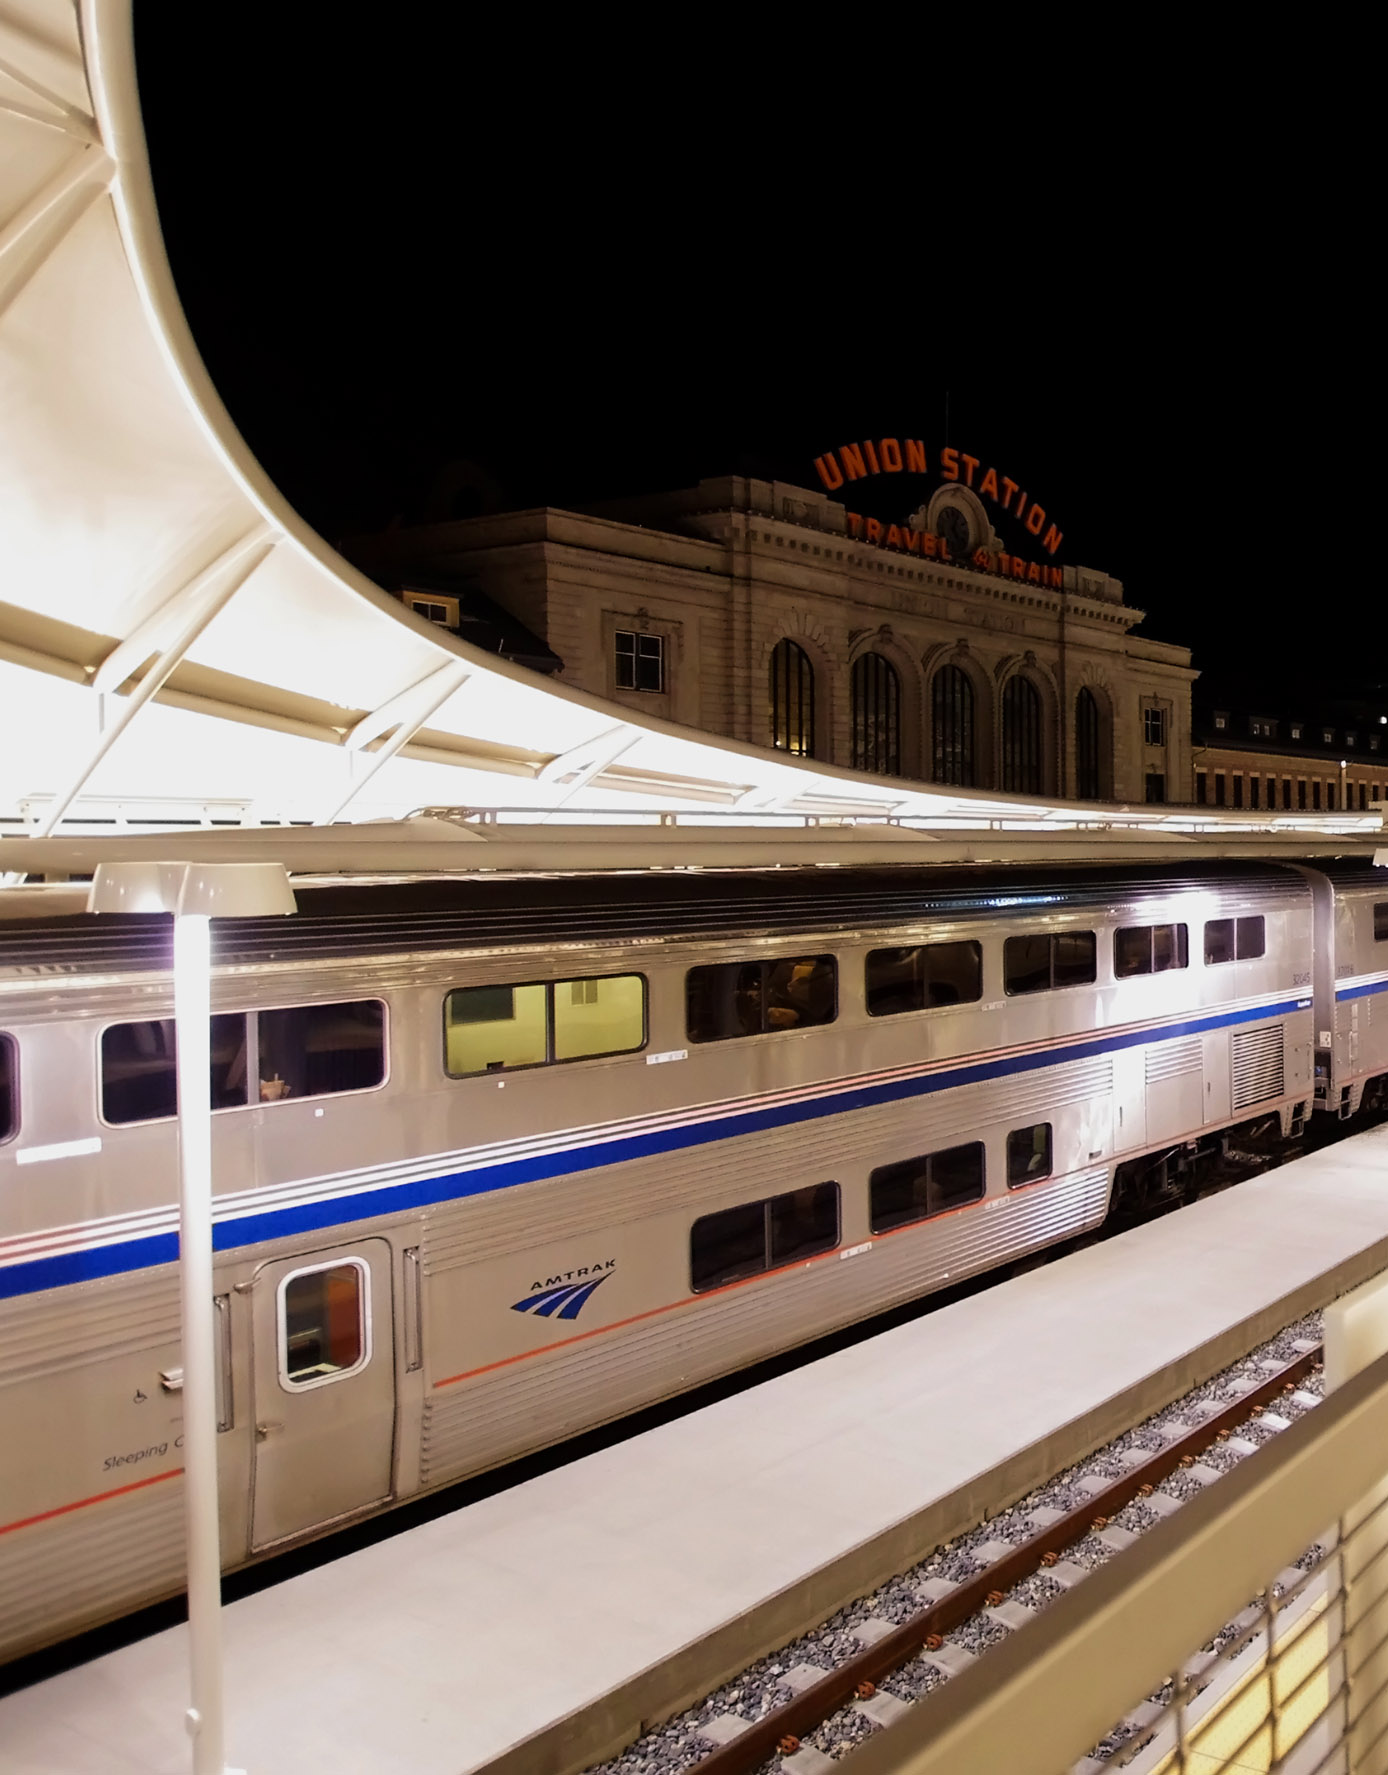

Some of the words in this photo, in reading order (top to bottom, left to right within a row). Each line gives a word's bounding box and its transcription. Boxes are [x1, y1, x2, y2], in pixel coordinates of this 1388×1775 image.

[813, 437, 928, 491] UNION
[940, 446, 1064, 555] STATION
[846, 511, 953, 561] TRAVEL
[997, 552, 1063, 589] TRAIN
[530, 1258, 616, 1292] AMTRAK
[102, 1441, 169, 1473] Sleeping
